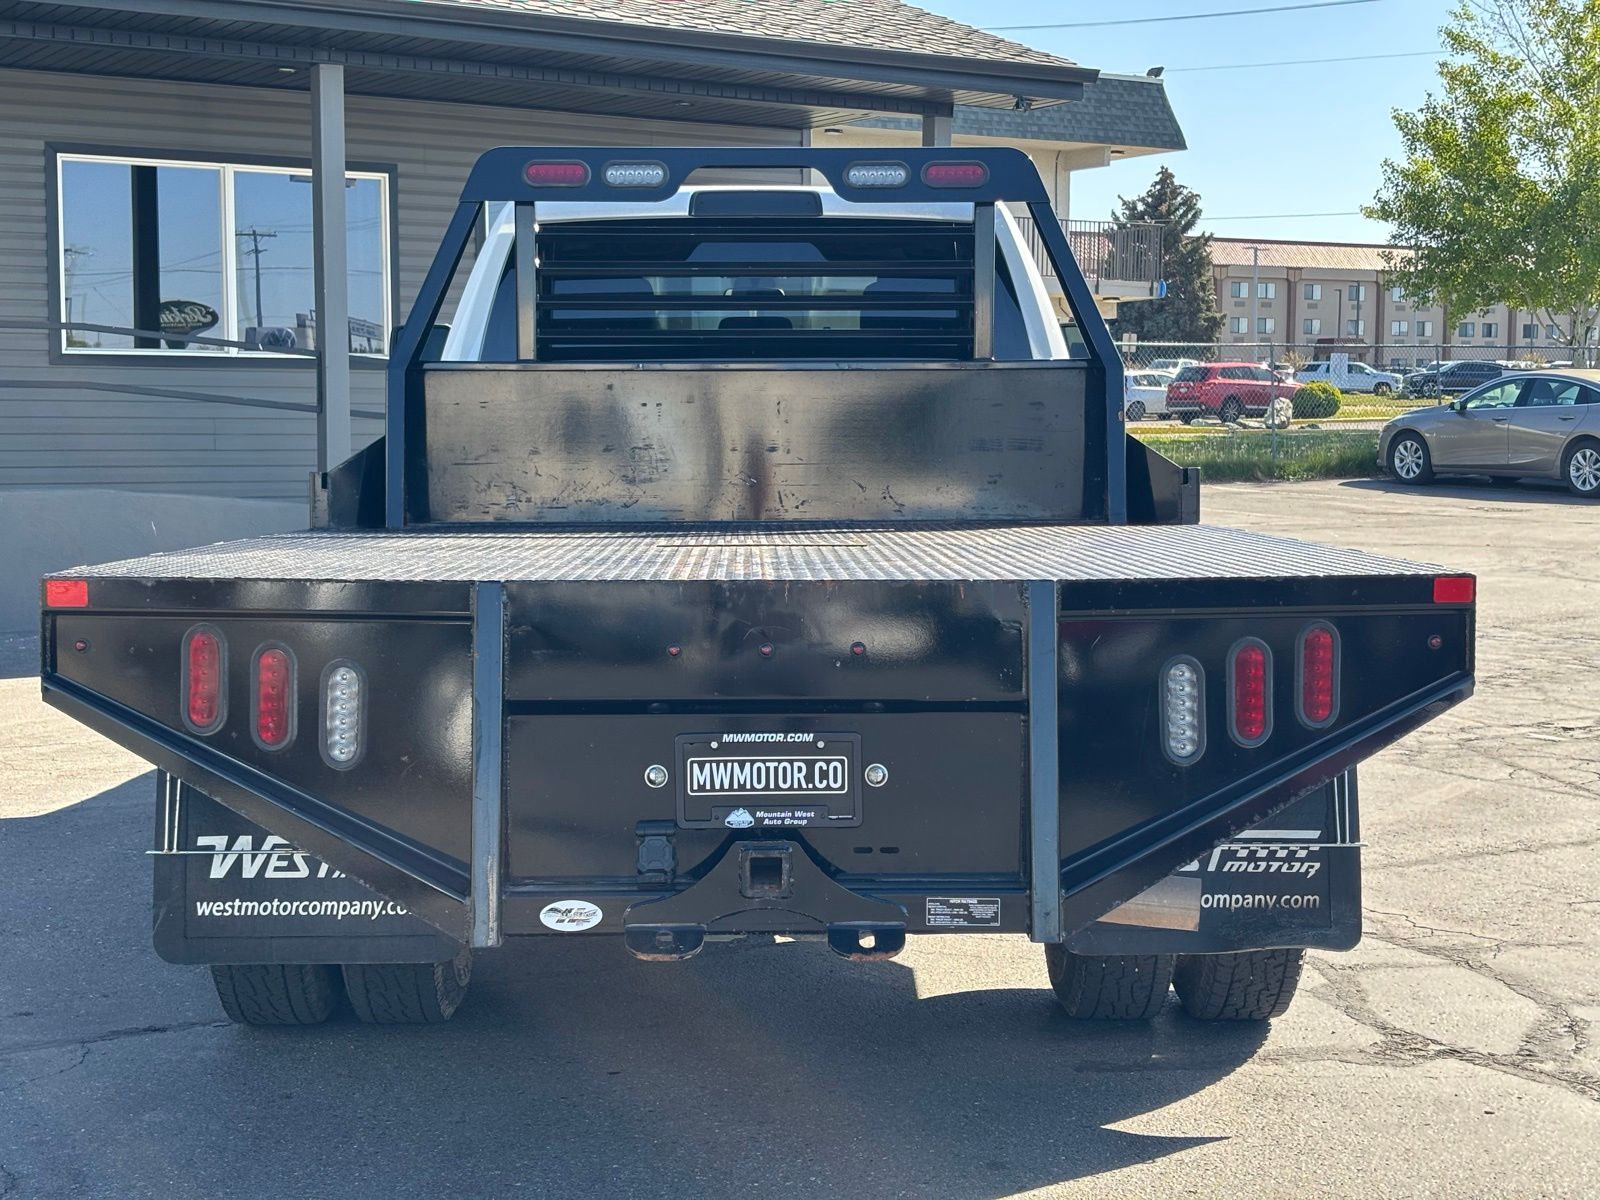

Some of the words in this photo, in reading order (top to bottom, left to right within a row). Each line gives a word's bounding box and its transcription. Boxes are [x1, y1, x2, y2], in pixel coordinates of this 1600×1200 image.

[722, 733, 814, 743] MWMOTOR.COM
[692, 761, 842, 790] MWMOTOR.CO
[755, 810, 792, 818] Mountain
[794, 810, 815, 818] West
[784, 818, 808, 826] Group
[196, 898, 413, 920] westmotorcompany.co
[1200, 893, 1320, 912] ompany.com
